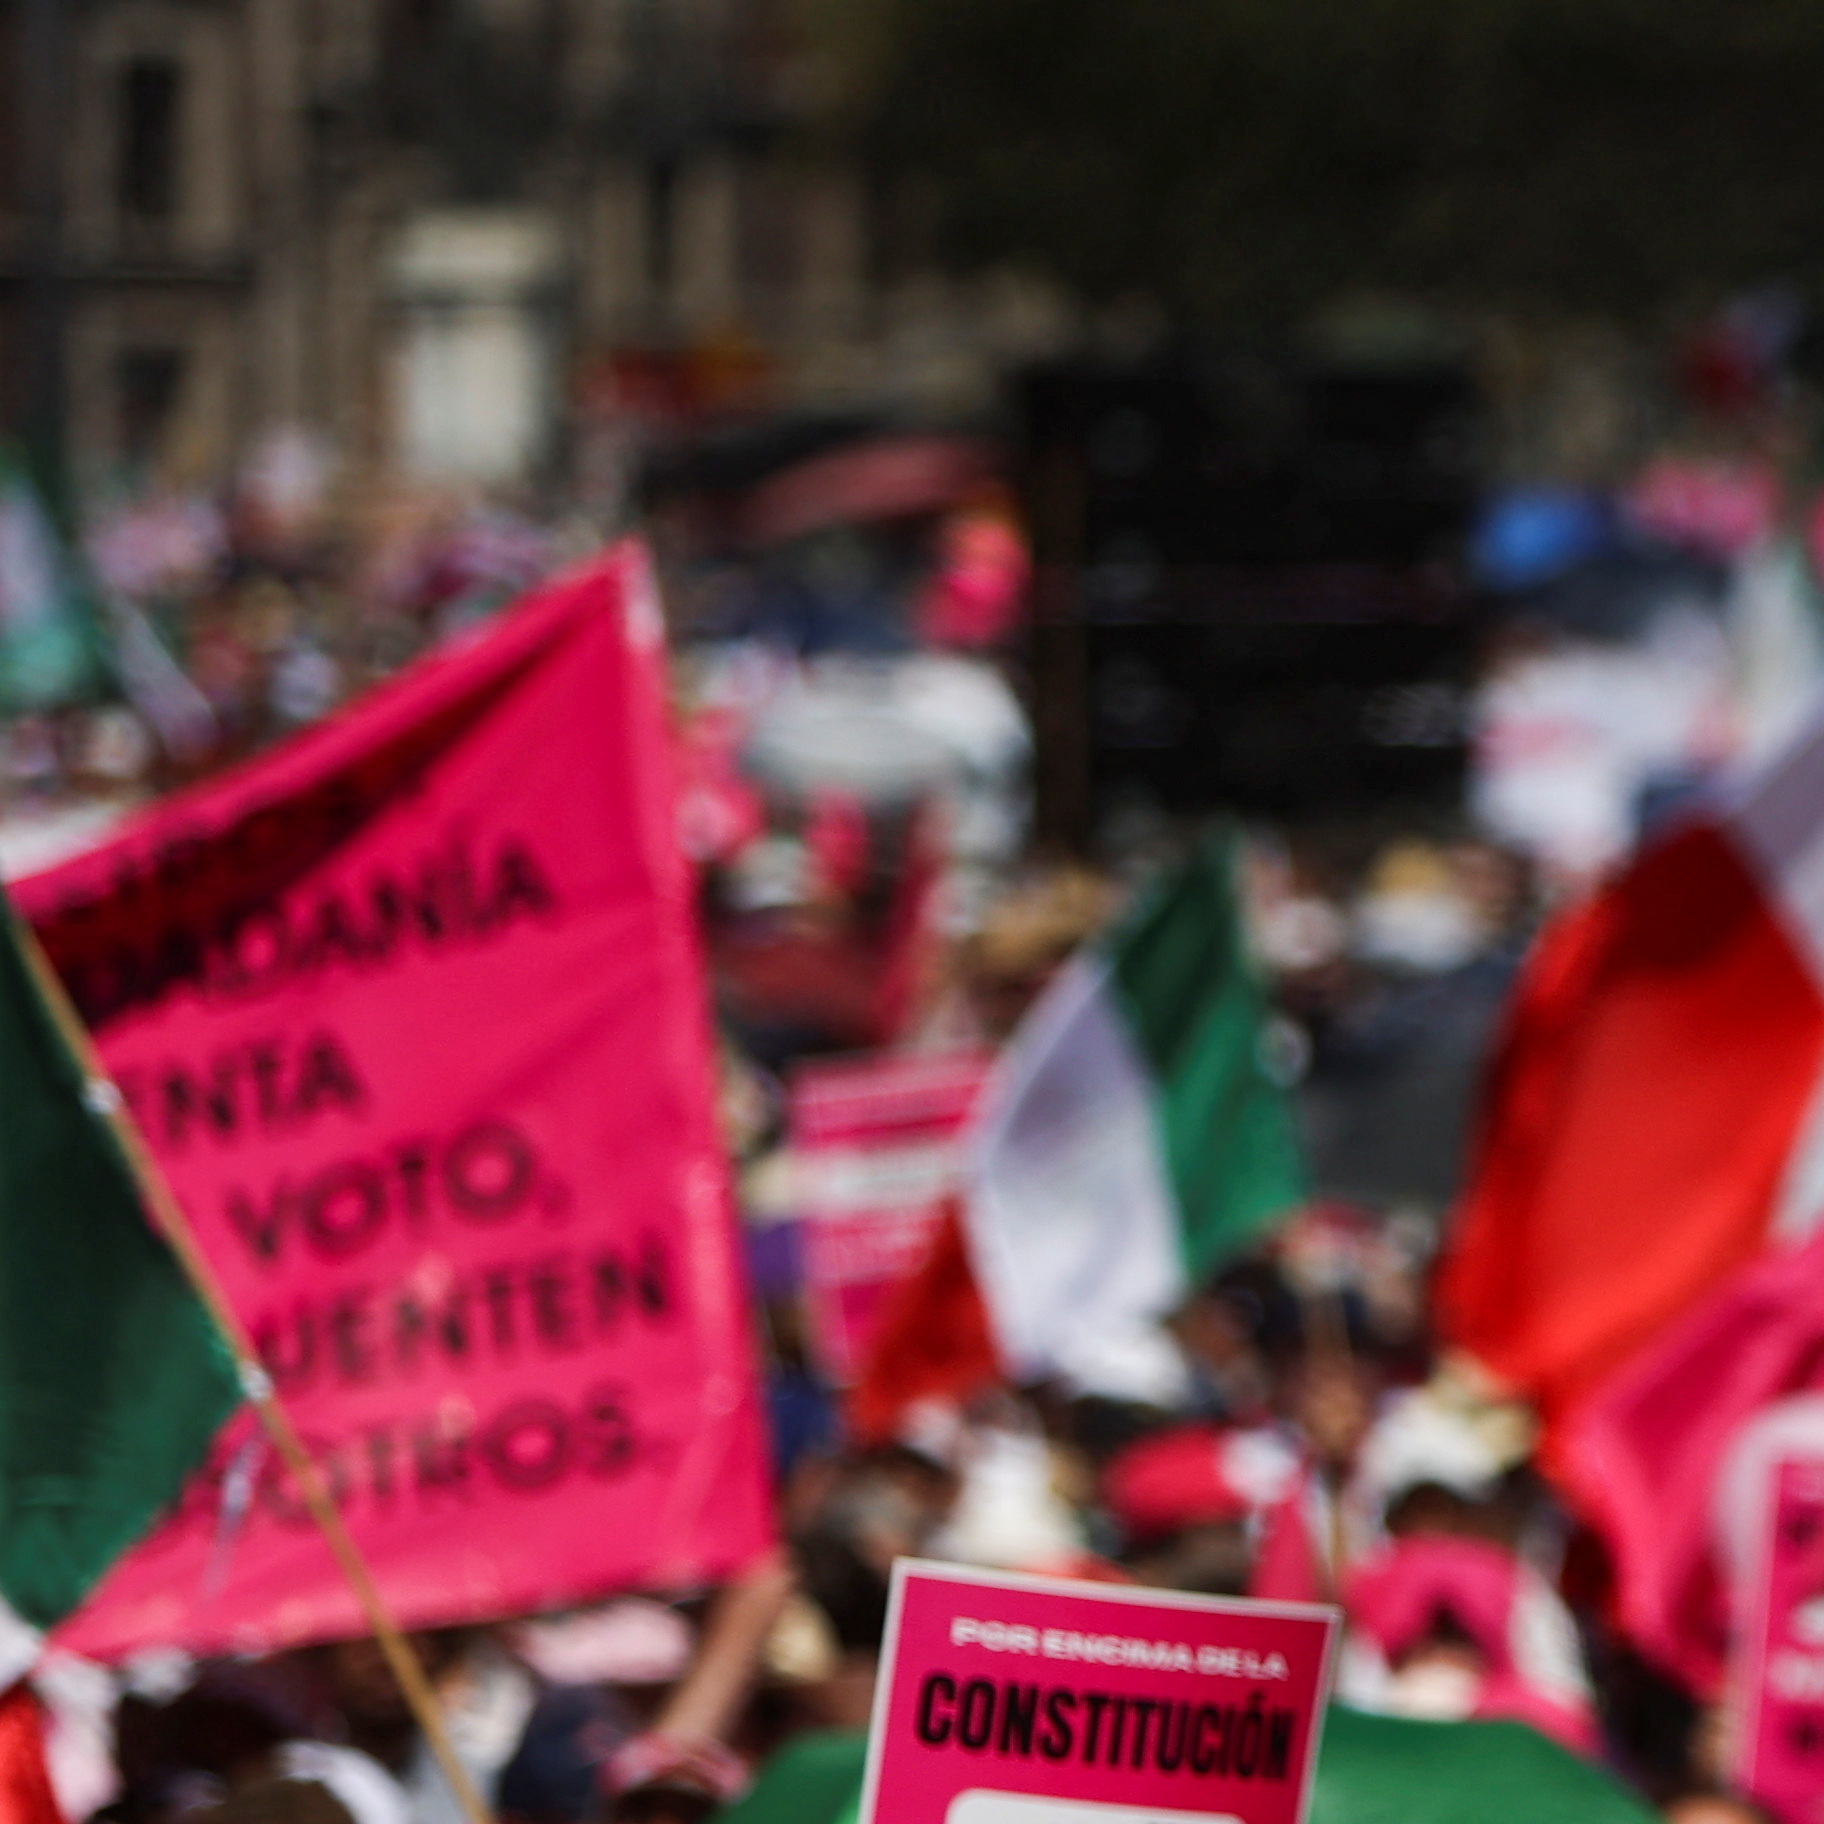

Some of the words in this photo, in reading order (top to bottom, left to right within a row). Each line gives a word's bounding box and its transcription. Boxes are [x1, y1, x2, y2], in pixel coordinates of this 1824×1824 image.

[258, 1228, 672, 1392] UENTEN
[951, 1617, 1040, 1656] POR
[917, 1674, 1297, 1781] CONSTITUCIÓN
